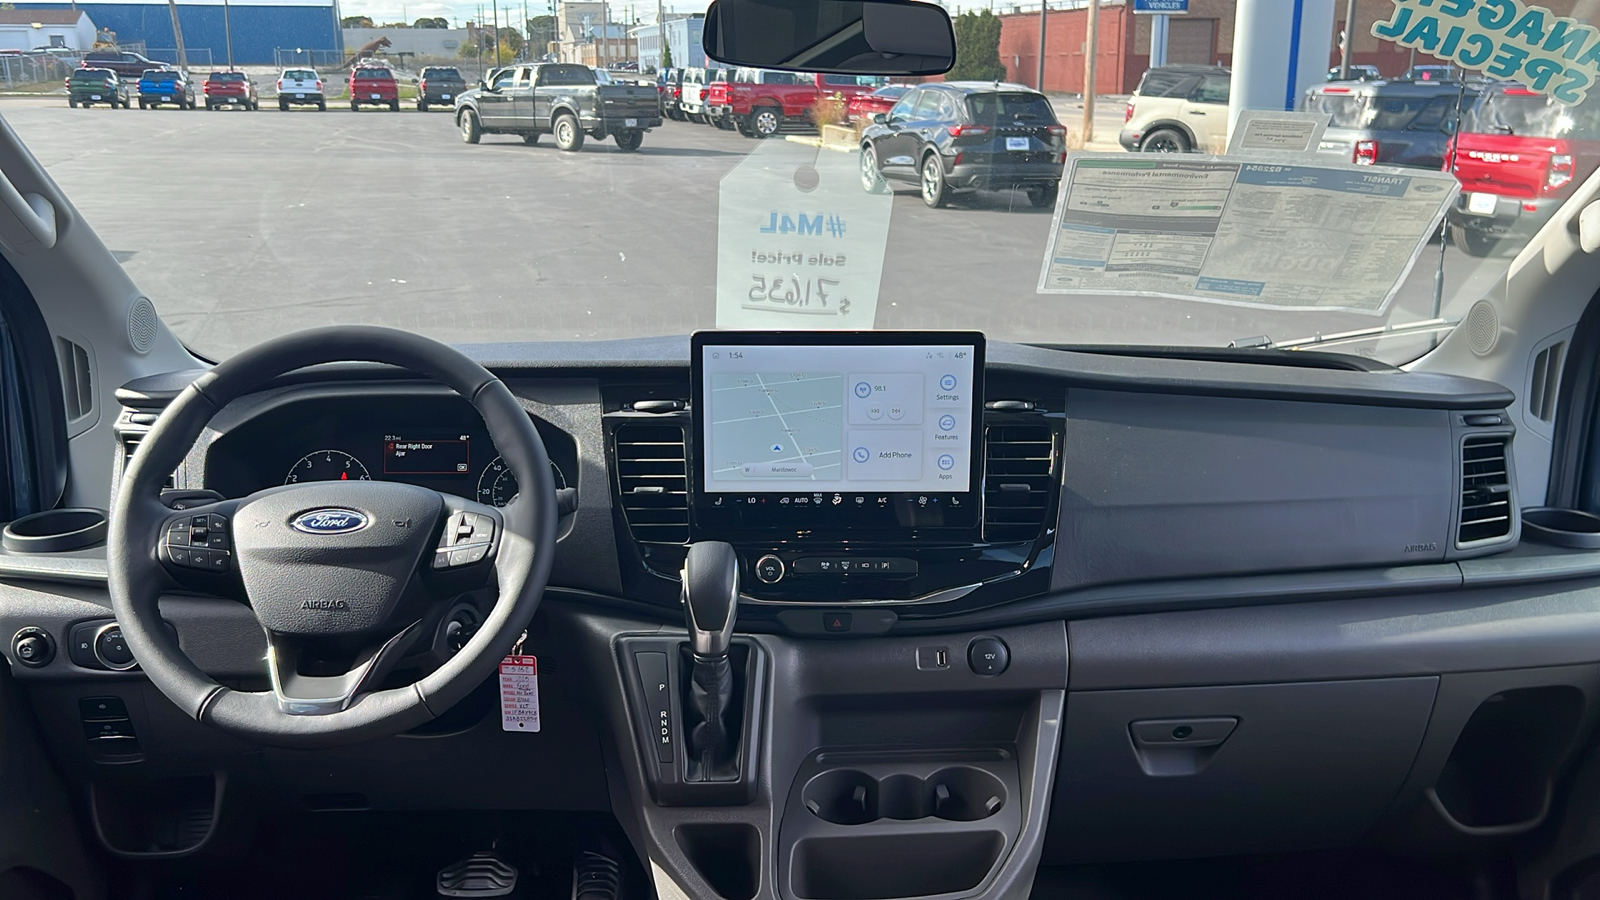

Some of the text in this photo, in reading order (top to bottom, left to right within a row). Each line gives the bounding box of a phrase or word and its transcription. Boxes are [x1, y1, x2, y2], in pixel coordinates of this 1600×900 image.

[1148, 1, 1181, 10] VEHICLES
[728, 352, 744, 360] 1:54
[954, 351, 967, 360] 48°
[936, 394, 959, 402] Settings
[408, 443, 421, 451] Right
[395, 450, 406, 458] Ajar
[879, 451, 912, 459] Add Phone
[306, 460, 312, 469] 3
[345, 461, 351, 469] 5
[292, 474, 298, 483] 2
[938, 472, 953, 481] Apps
[310, 513, 350, 528] Ford
[1404, 543, 1436, 553] AIRBAG
[301, 600, 346, 609] AIRBAG
[659, 683, 665, 691] P
[662, 736, 669, 744] M
